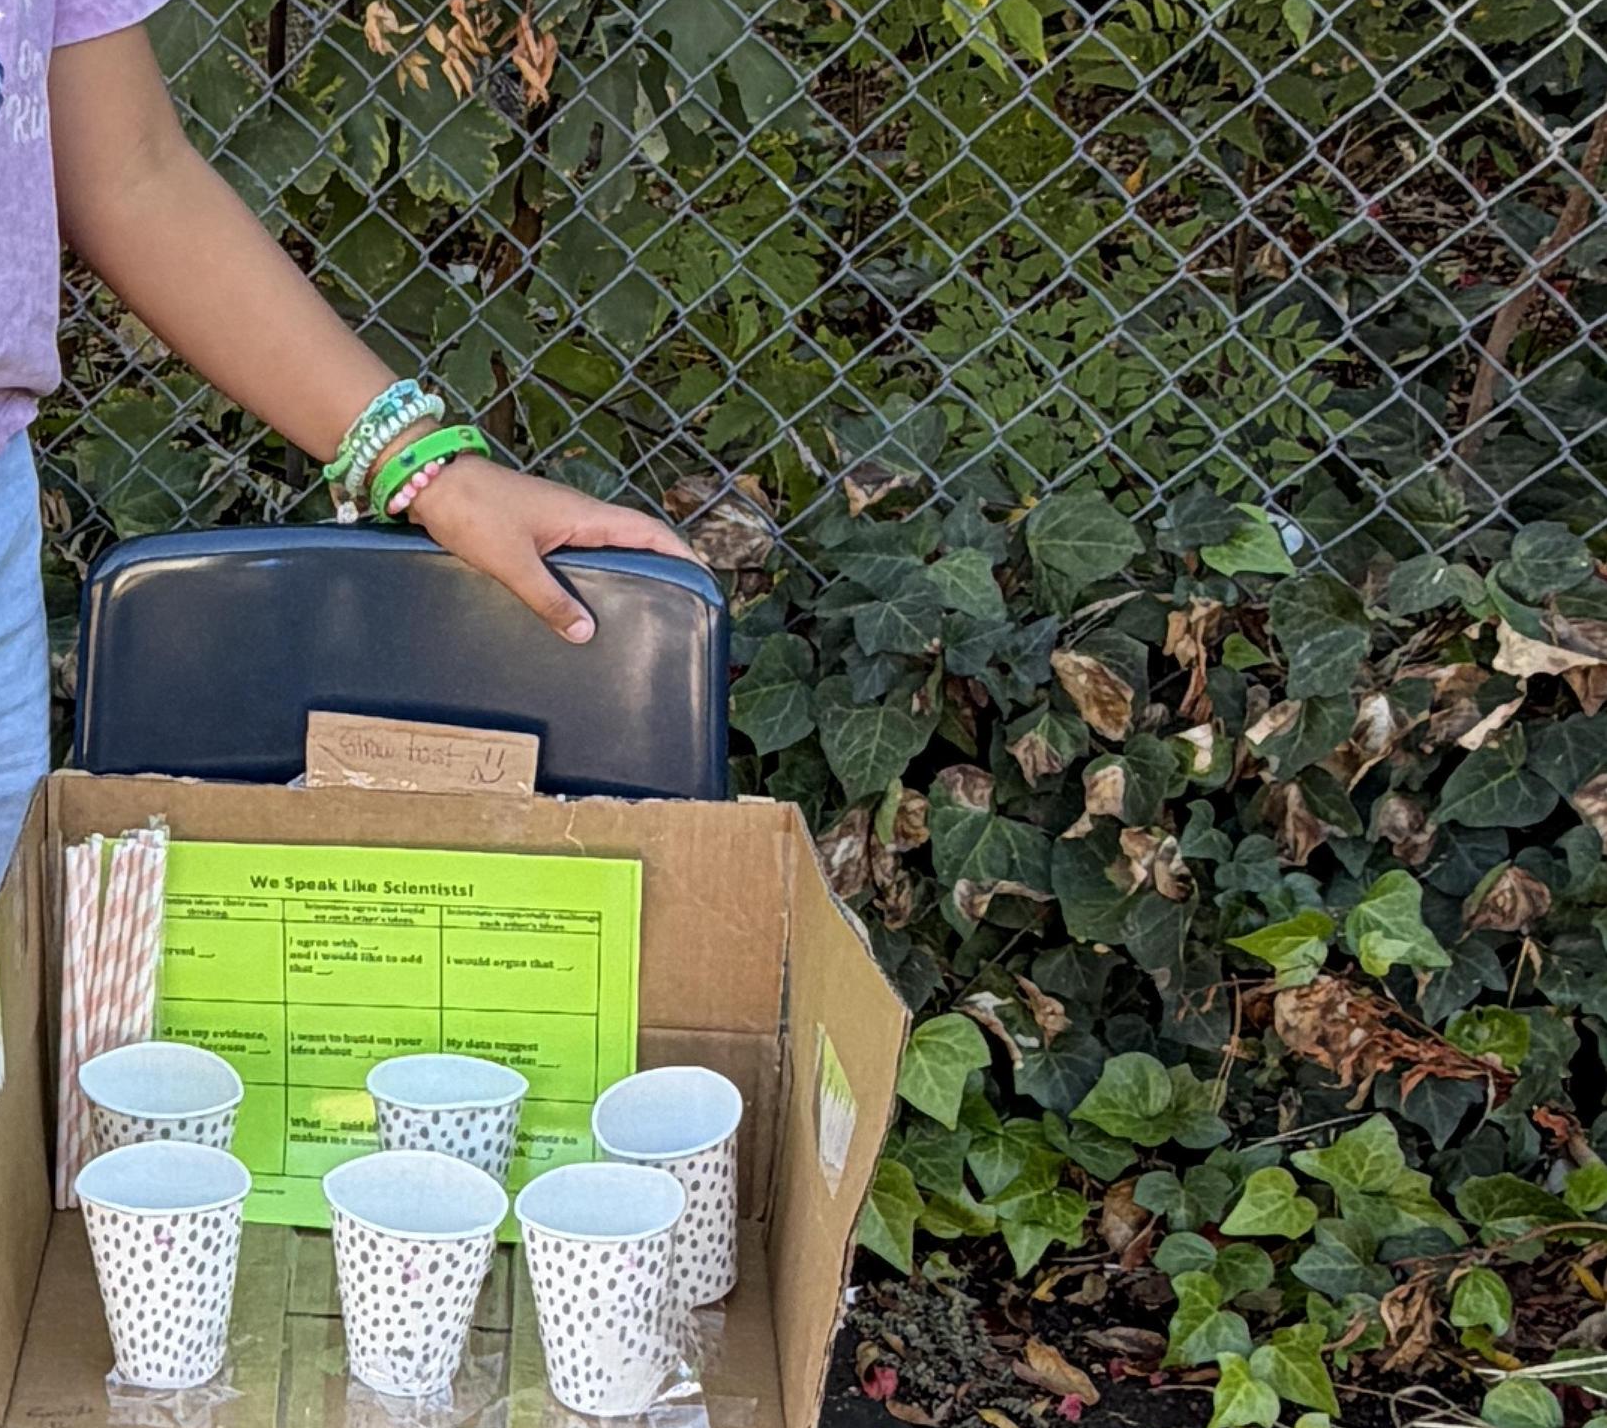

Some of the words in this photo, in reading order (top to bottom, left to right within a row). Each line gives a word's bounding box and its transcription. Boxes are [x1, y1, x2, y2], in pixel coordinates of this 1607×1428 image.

[250, 875, 279, 889] We
[284, 877, 338, 893] Speak
[343, 879, 377, 894] Like
[383, 880, 475, 898] Scientists!
[296, 939, 329, 949] agree
[332, 938, 359, 948] with
[289, 951, 312, 961] and
[320, 951, 358, 962] would
[360, 952, 384, 963] like
[385, 954, 398, 964] to
[400, 954, 423, 965] add
[453, 956, 491, 967] would
[493, 958, 527, 970] argue
[530, 959, 555, 969] that
